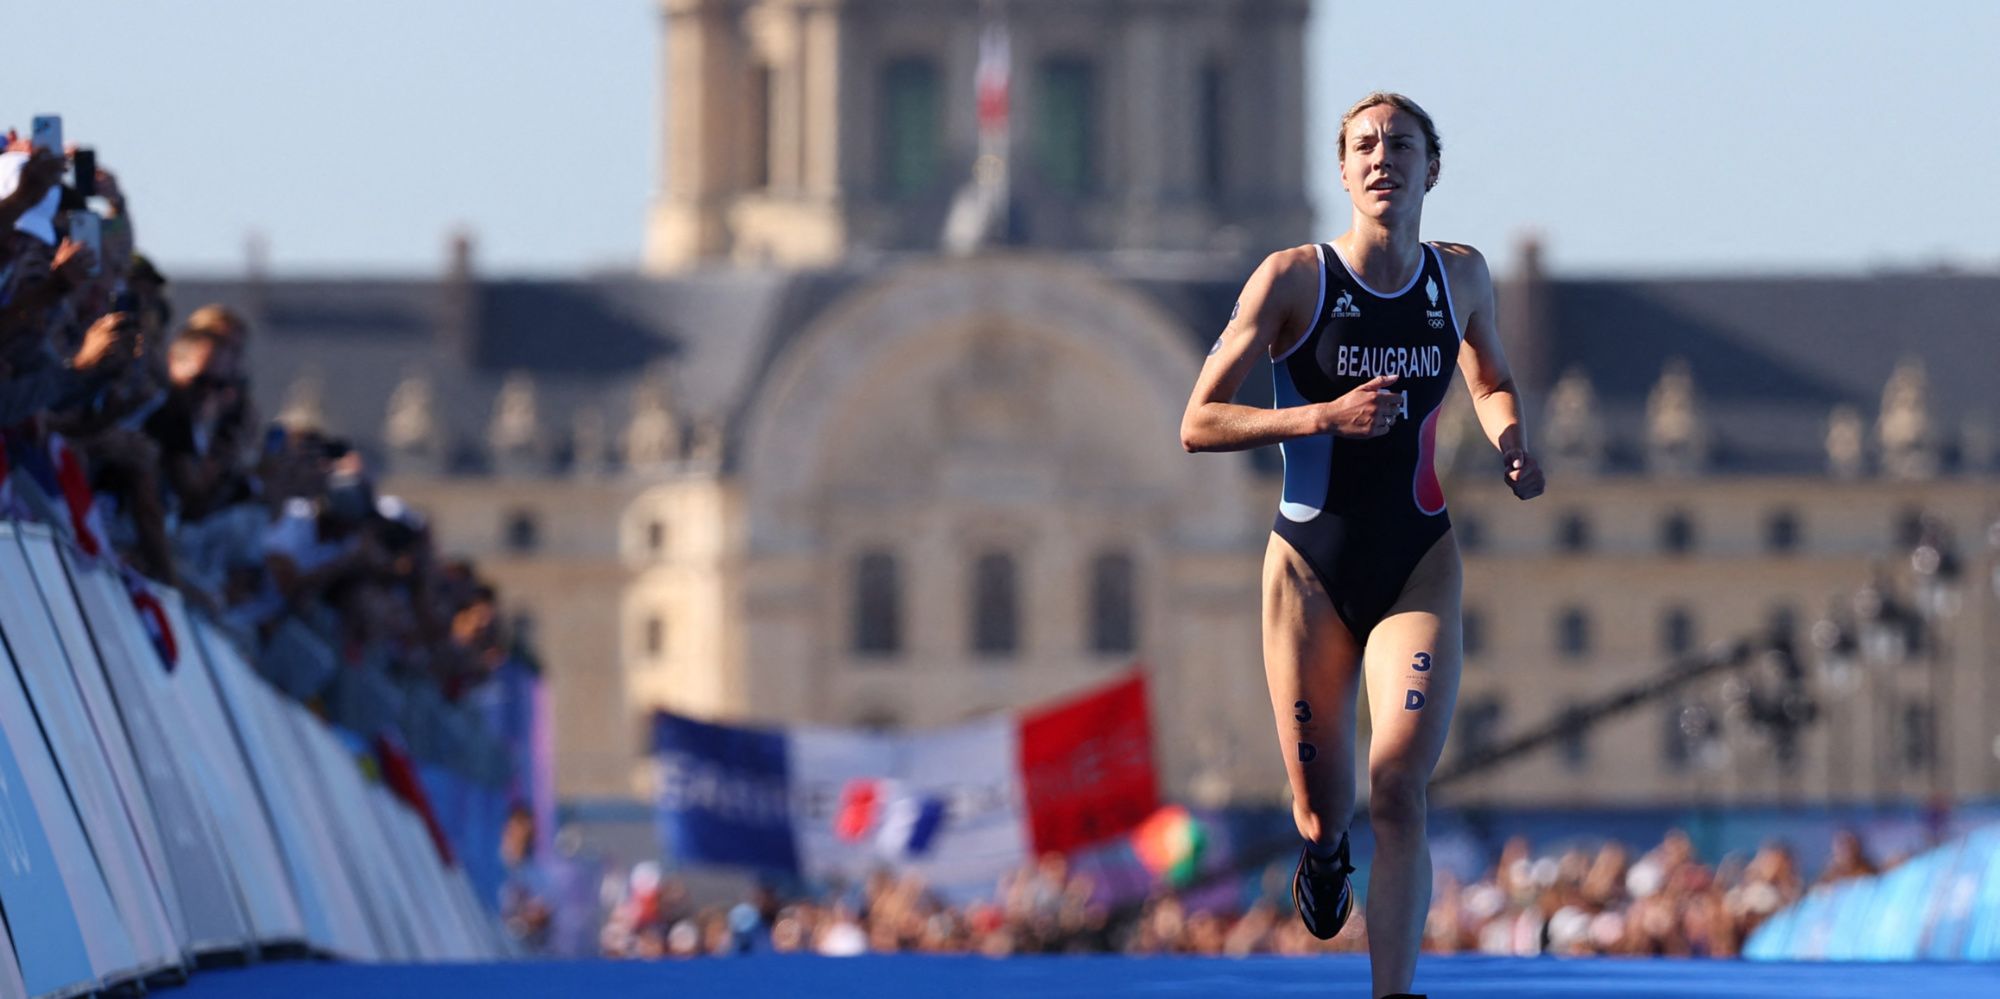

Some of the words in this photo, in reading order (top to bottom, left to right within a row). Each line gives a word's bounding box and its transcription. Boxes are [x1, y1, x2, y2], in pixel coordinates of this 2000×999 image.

[1337, 345, 1441, 378] BEAUGRAND
[1411, 652, 1431, 672] 3
[1404, 689, 1426, 711] D
[1294, 700, 1312, 723] 3
[1297, 742, 1317, 762] D
